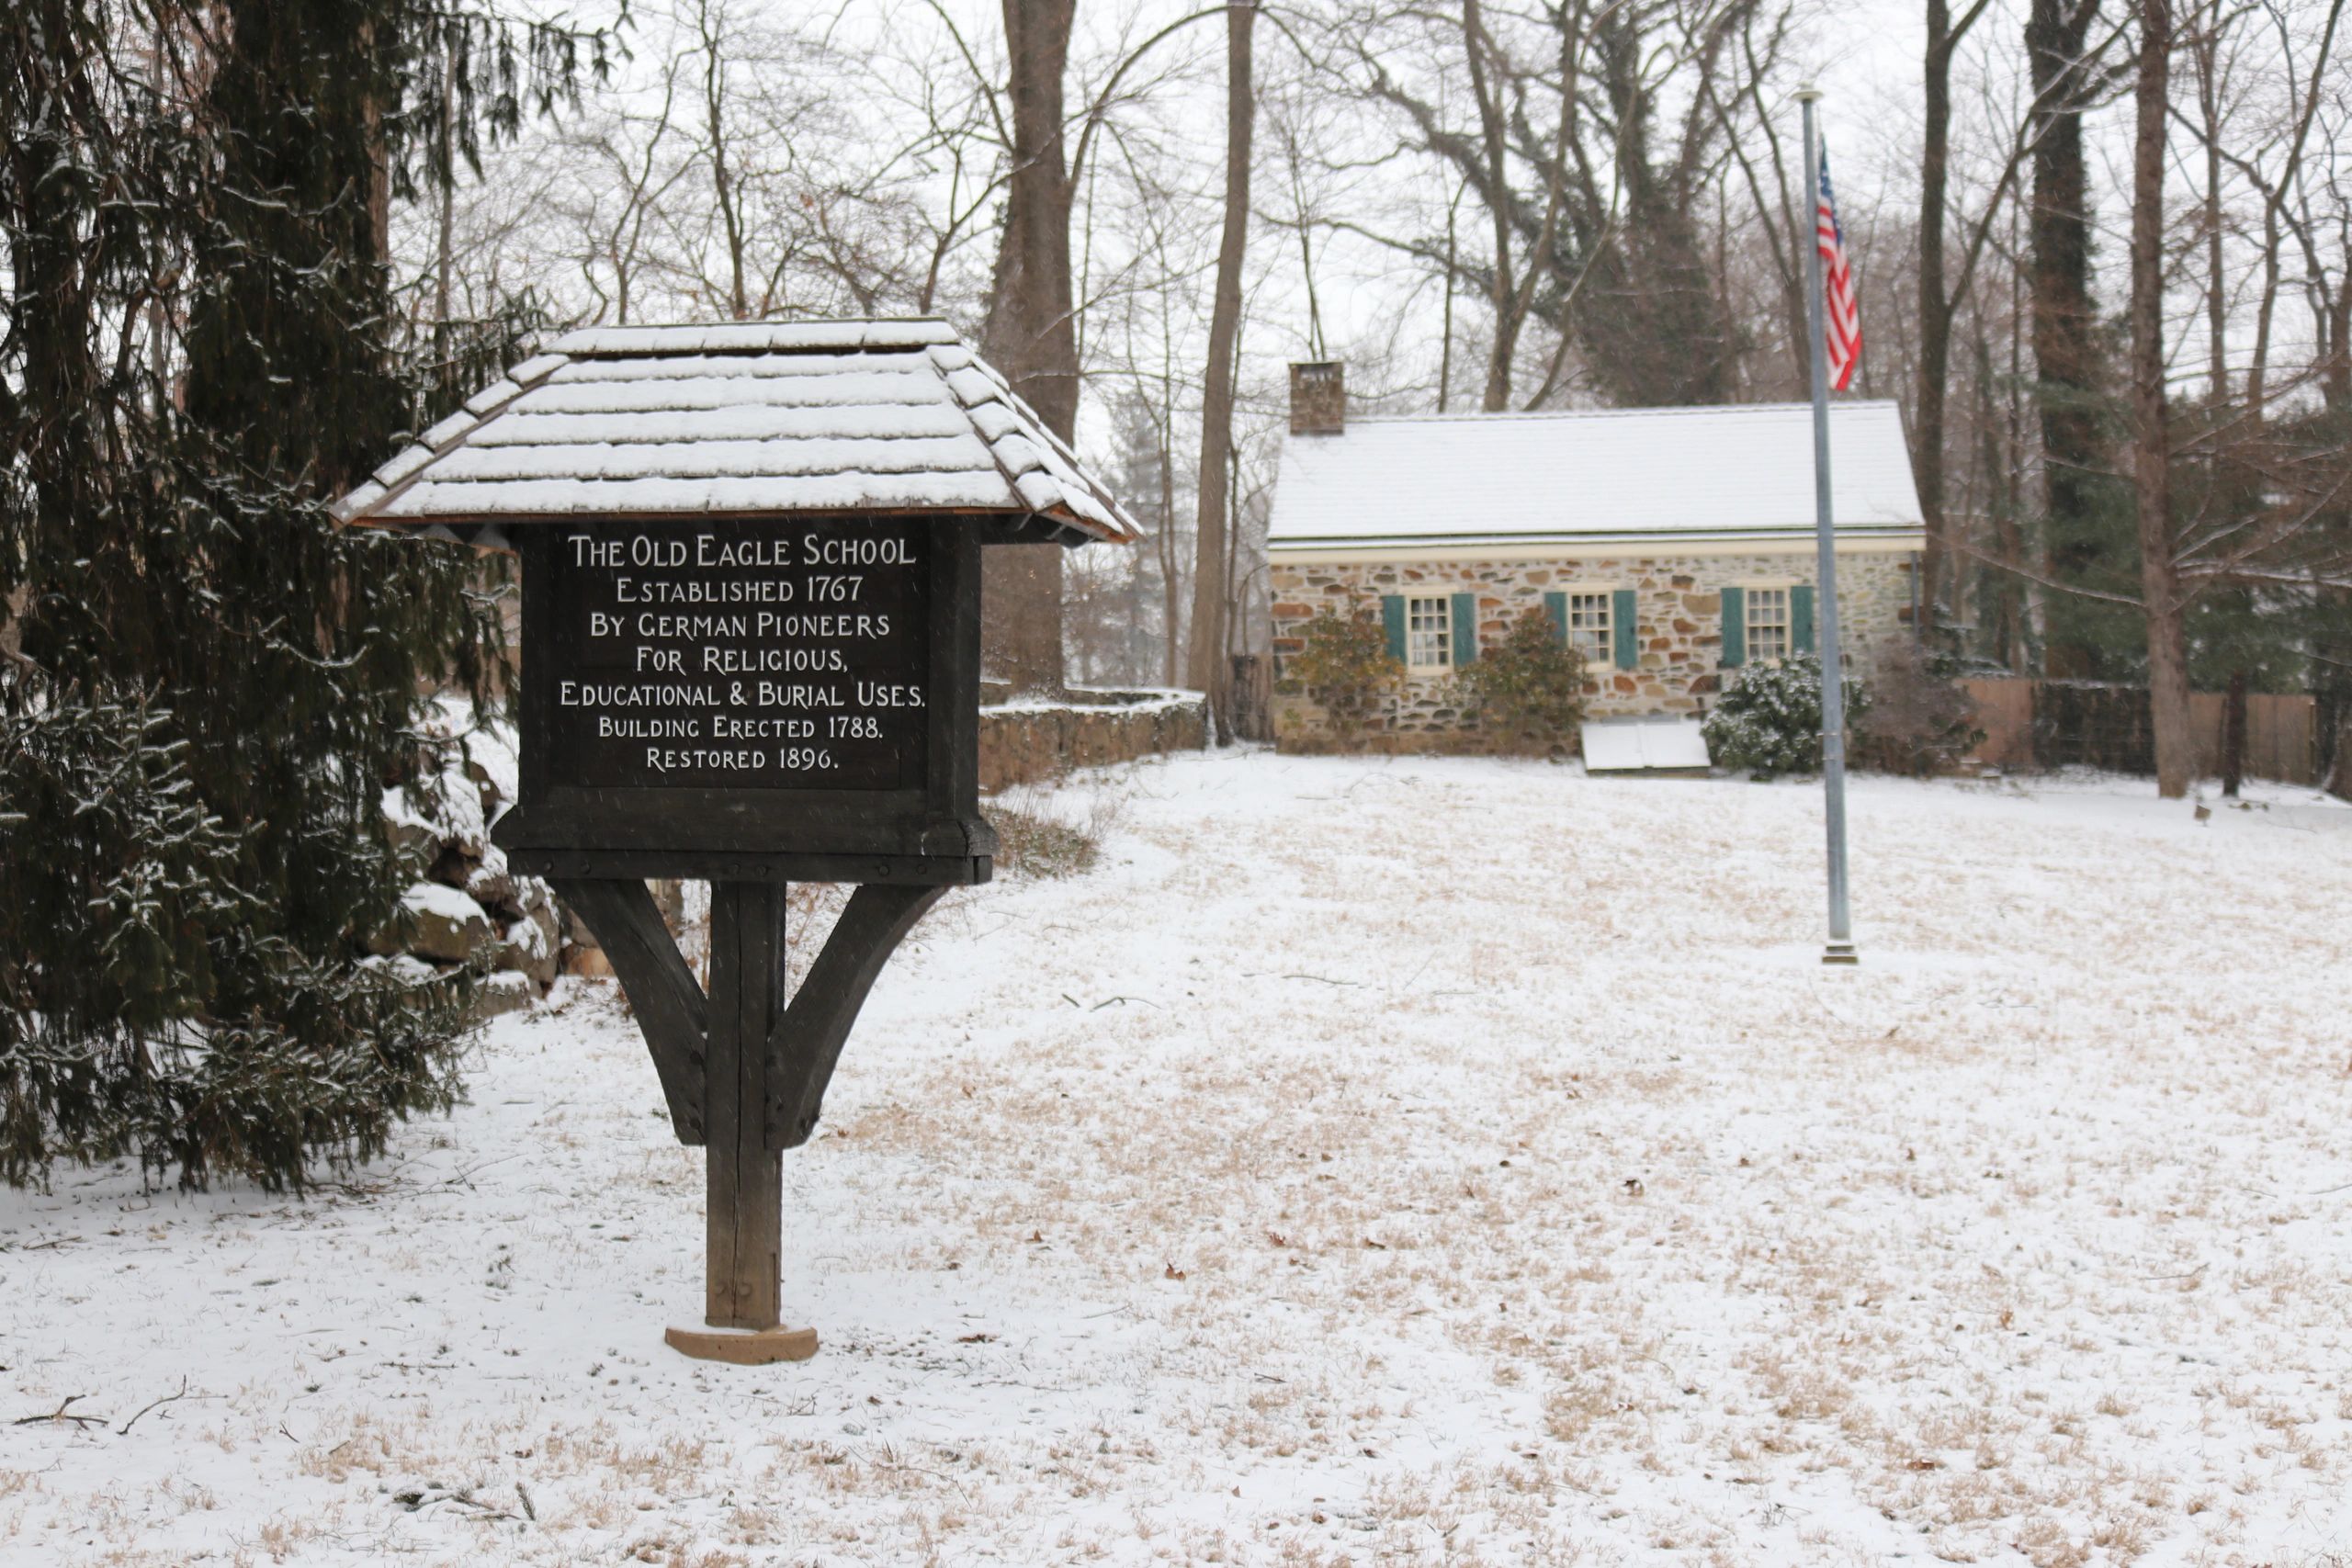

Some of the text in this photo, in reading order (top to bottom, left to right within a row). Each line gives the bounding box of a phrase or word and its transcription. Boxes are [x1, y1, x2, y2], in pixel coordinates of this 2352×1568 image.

[569, 535, 916, 566] THE OLD EAGLE SCHOOL
[617, 577, 863, 602] ESTABLISHED 1767
[592, 613, 889, 640] BY GERMAN PIONEERS
[638, 647, 847, 675] FOR RELIGIOUS,
[561, 682, 925, 709] EDUCATIONAL & BURIAL USES.
[600, 716, 882, 739] BUILDING ERECTED 1788.
[648, 748, 838, 773] RESTORED 1896.
